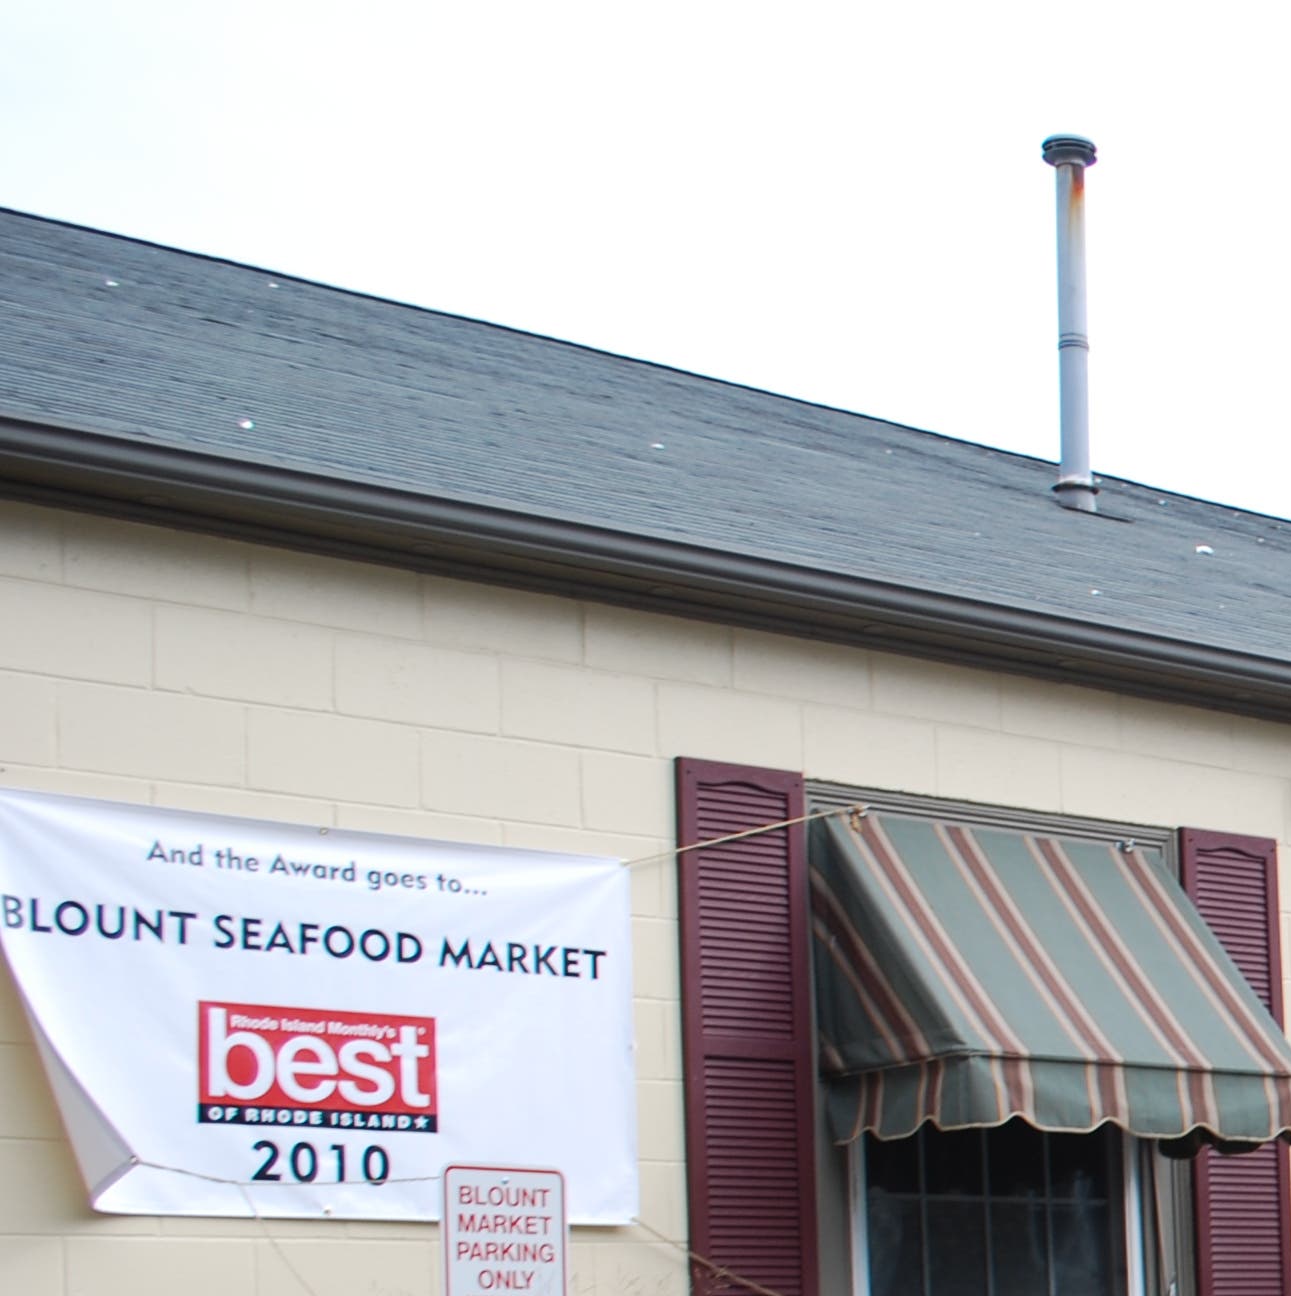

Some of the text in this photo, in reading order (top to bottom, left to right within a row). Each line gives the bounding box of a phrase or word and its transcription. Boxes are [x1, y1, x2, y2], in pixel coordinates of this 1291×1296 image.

[147, 839, 489, 897] And the Award goes to...
[2, 894, 609, 981] BLOUNT SEAFOOD MARKET
[230, 1014, 280, 1032] Rhode
[280, 1018, 326, 1035] Island
[207, 1006, 432, 1108] best
[207, 1106, 413, 1130] OF RHODE ISLAND
[251, 1140, 390, 1185] 2010
[458, 1185, 550, 1207] BLOUNT
[457, 1214, 552, 1235] MARKET
[456, 1241, 555, 1263] PARKING
[478, 1269, 535, 1290] ONLY
